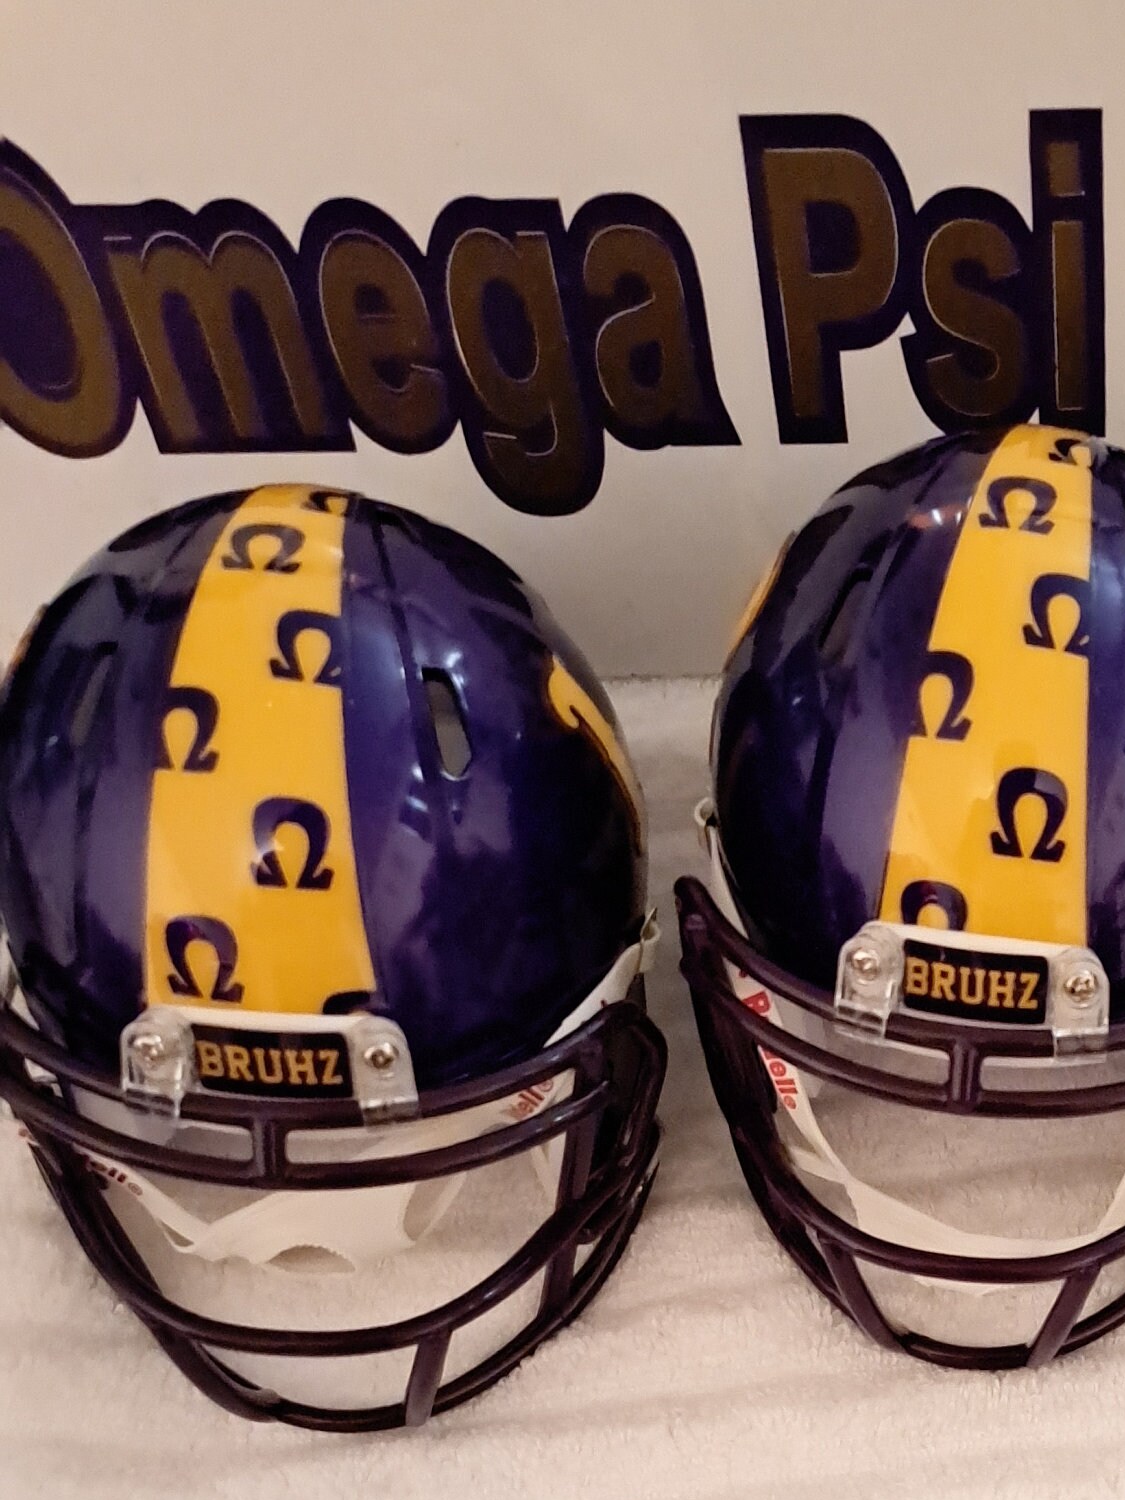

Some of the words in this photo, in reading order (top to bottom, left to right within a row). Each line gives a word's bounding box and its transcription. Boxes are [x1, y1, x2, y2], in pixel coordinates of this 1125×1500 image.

[0, 136, 743, 516] Omega
[738, 107, 1106, 444] Psi
[905, 956, 1040, 1009] BRUHZ
[195, 1040, 343, 1085] BRUHZ
